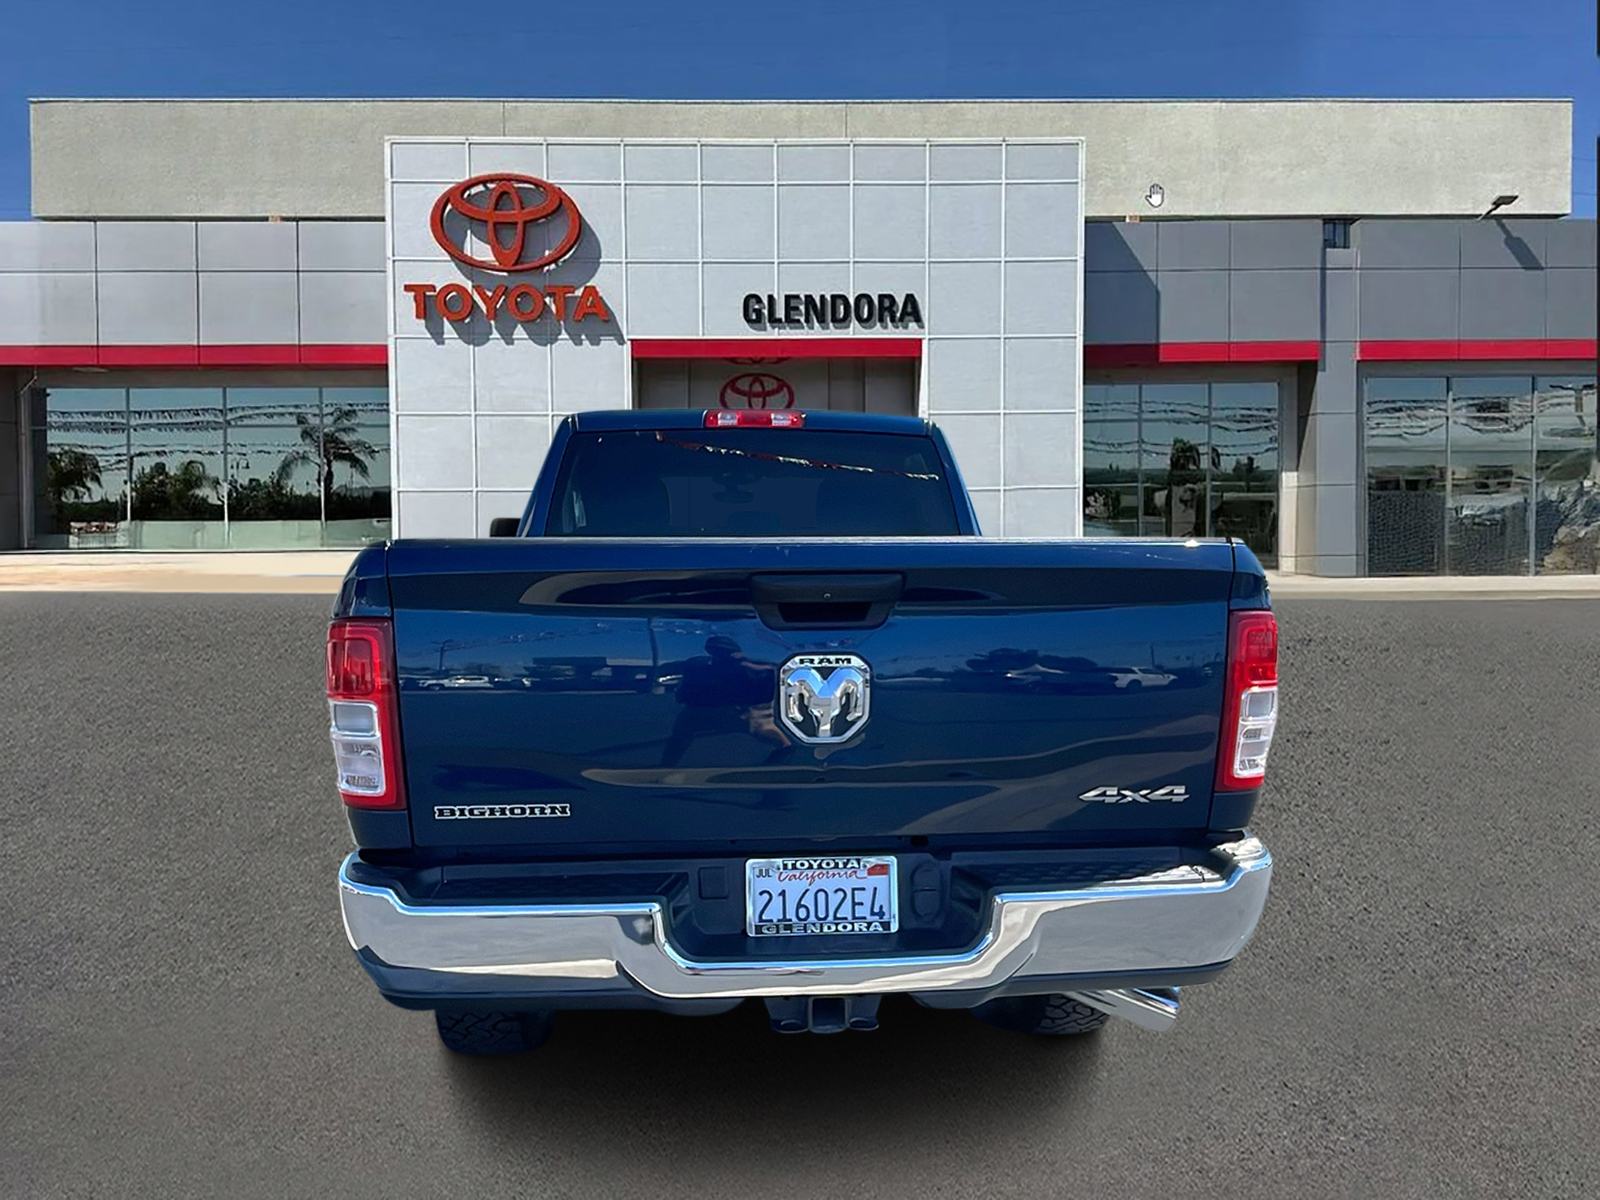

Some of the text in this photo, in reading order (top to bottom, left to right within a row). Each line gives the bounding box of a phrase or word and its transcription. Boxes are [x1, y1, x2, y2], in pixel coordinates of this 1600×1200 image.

[404, 283, 611, 323] TOYOTA
[743, 293, 922, 326] GLENDORA
[434, 804, 571, 819] BIGHORN
[784, 859, 859, 870] TOYOTA
[756, 868, 772, 878] JUL
[777, 869, 867, 886] California
[758, 887, 886, 923] 21602E4
[761, 922, 884, 934] GLENDORA
